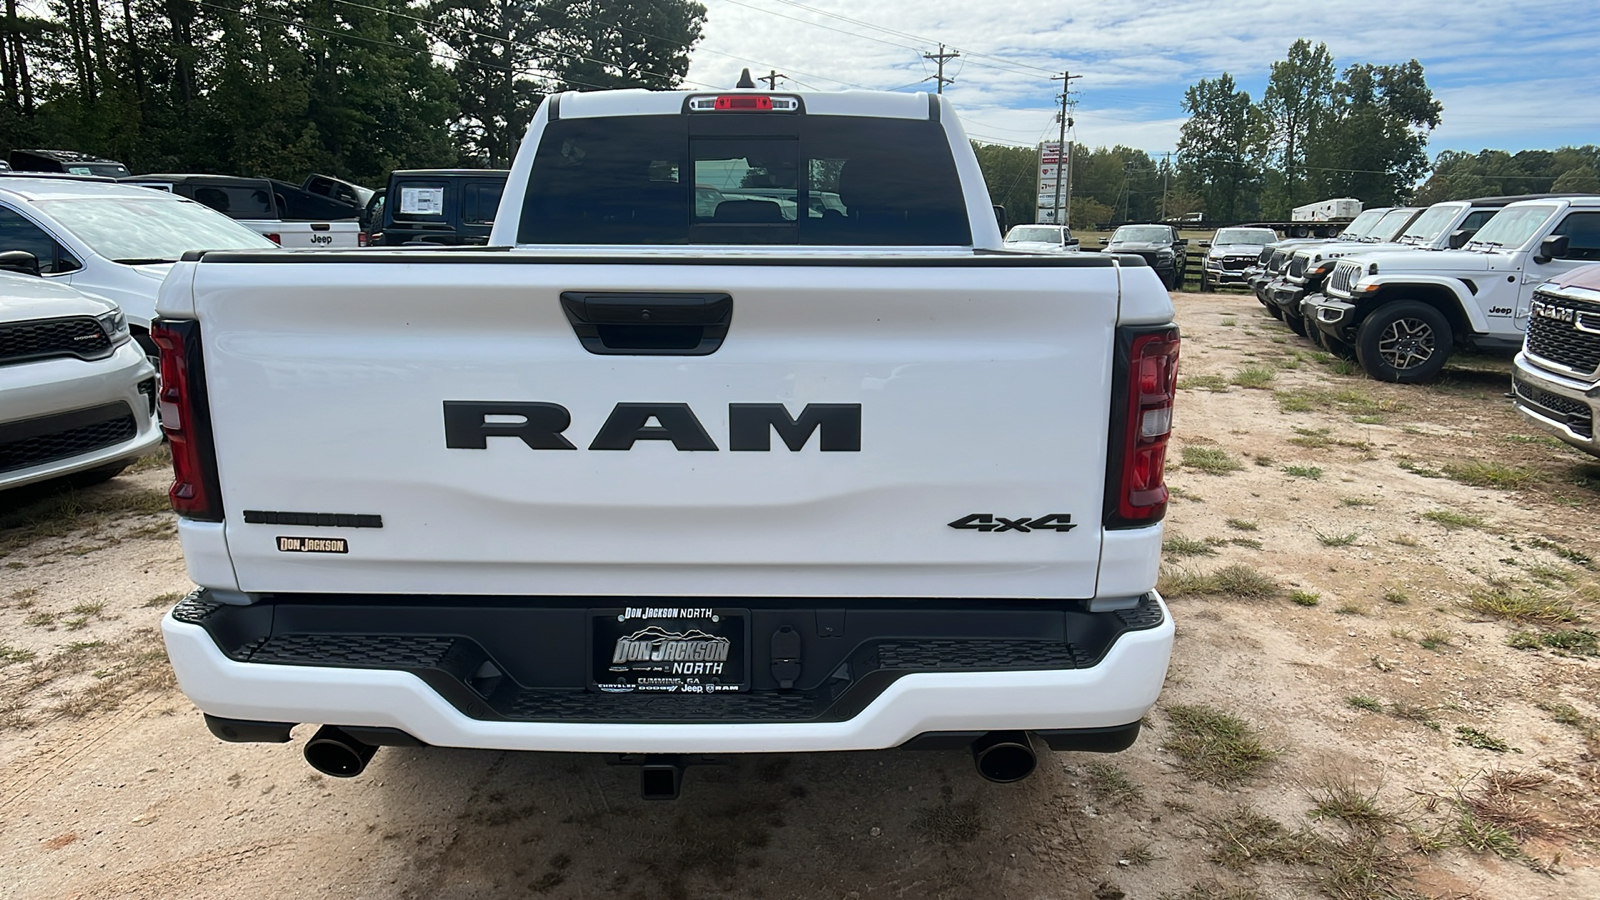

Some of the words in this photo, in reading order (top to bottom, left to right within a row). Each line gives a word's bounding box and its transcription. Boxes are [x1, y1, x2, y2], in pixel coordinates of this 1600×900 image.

[310, 234, 332, 245] Jeep
[1489, 306, 1513, 315] Jeep
[1532, 301, 1574, 322] RAM
[443, 400, 862, 452] RAM
[947, 513, 1078, 533] 4x4
[280, 537, 300, 550] DON
[301, 538, 344, 552] JACKSON
[625, 607, 642, 619] DON
[642, 607, 678, 619] JACKSON
[680, 608, 712, 618] NORTH
[612, 640, 652, 663] DON
[651, 641, 730, 661] JACKSON
[672, 663, 723, 674] NORTH
[681, 684, 703, 693] Jeep
